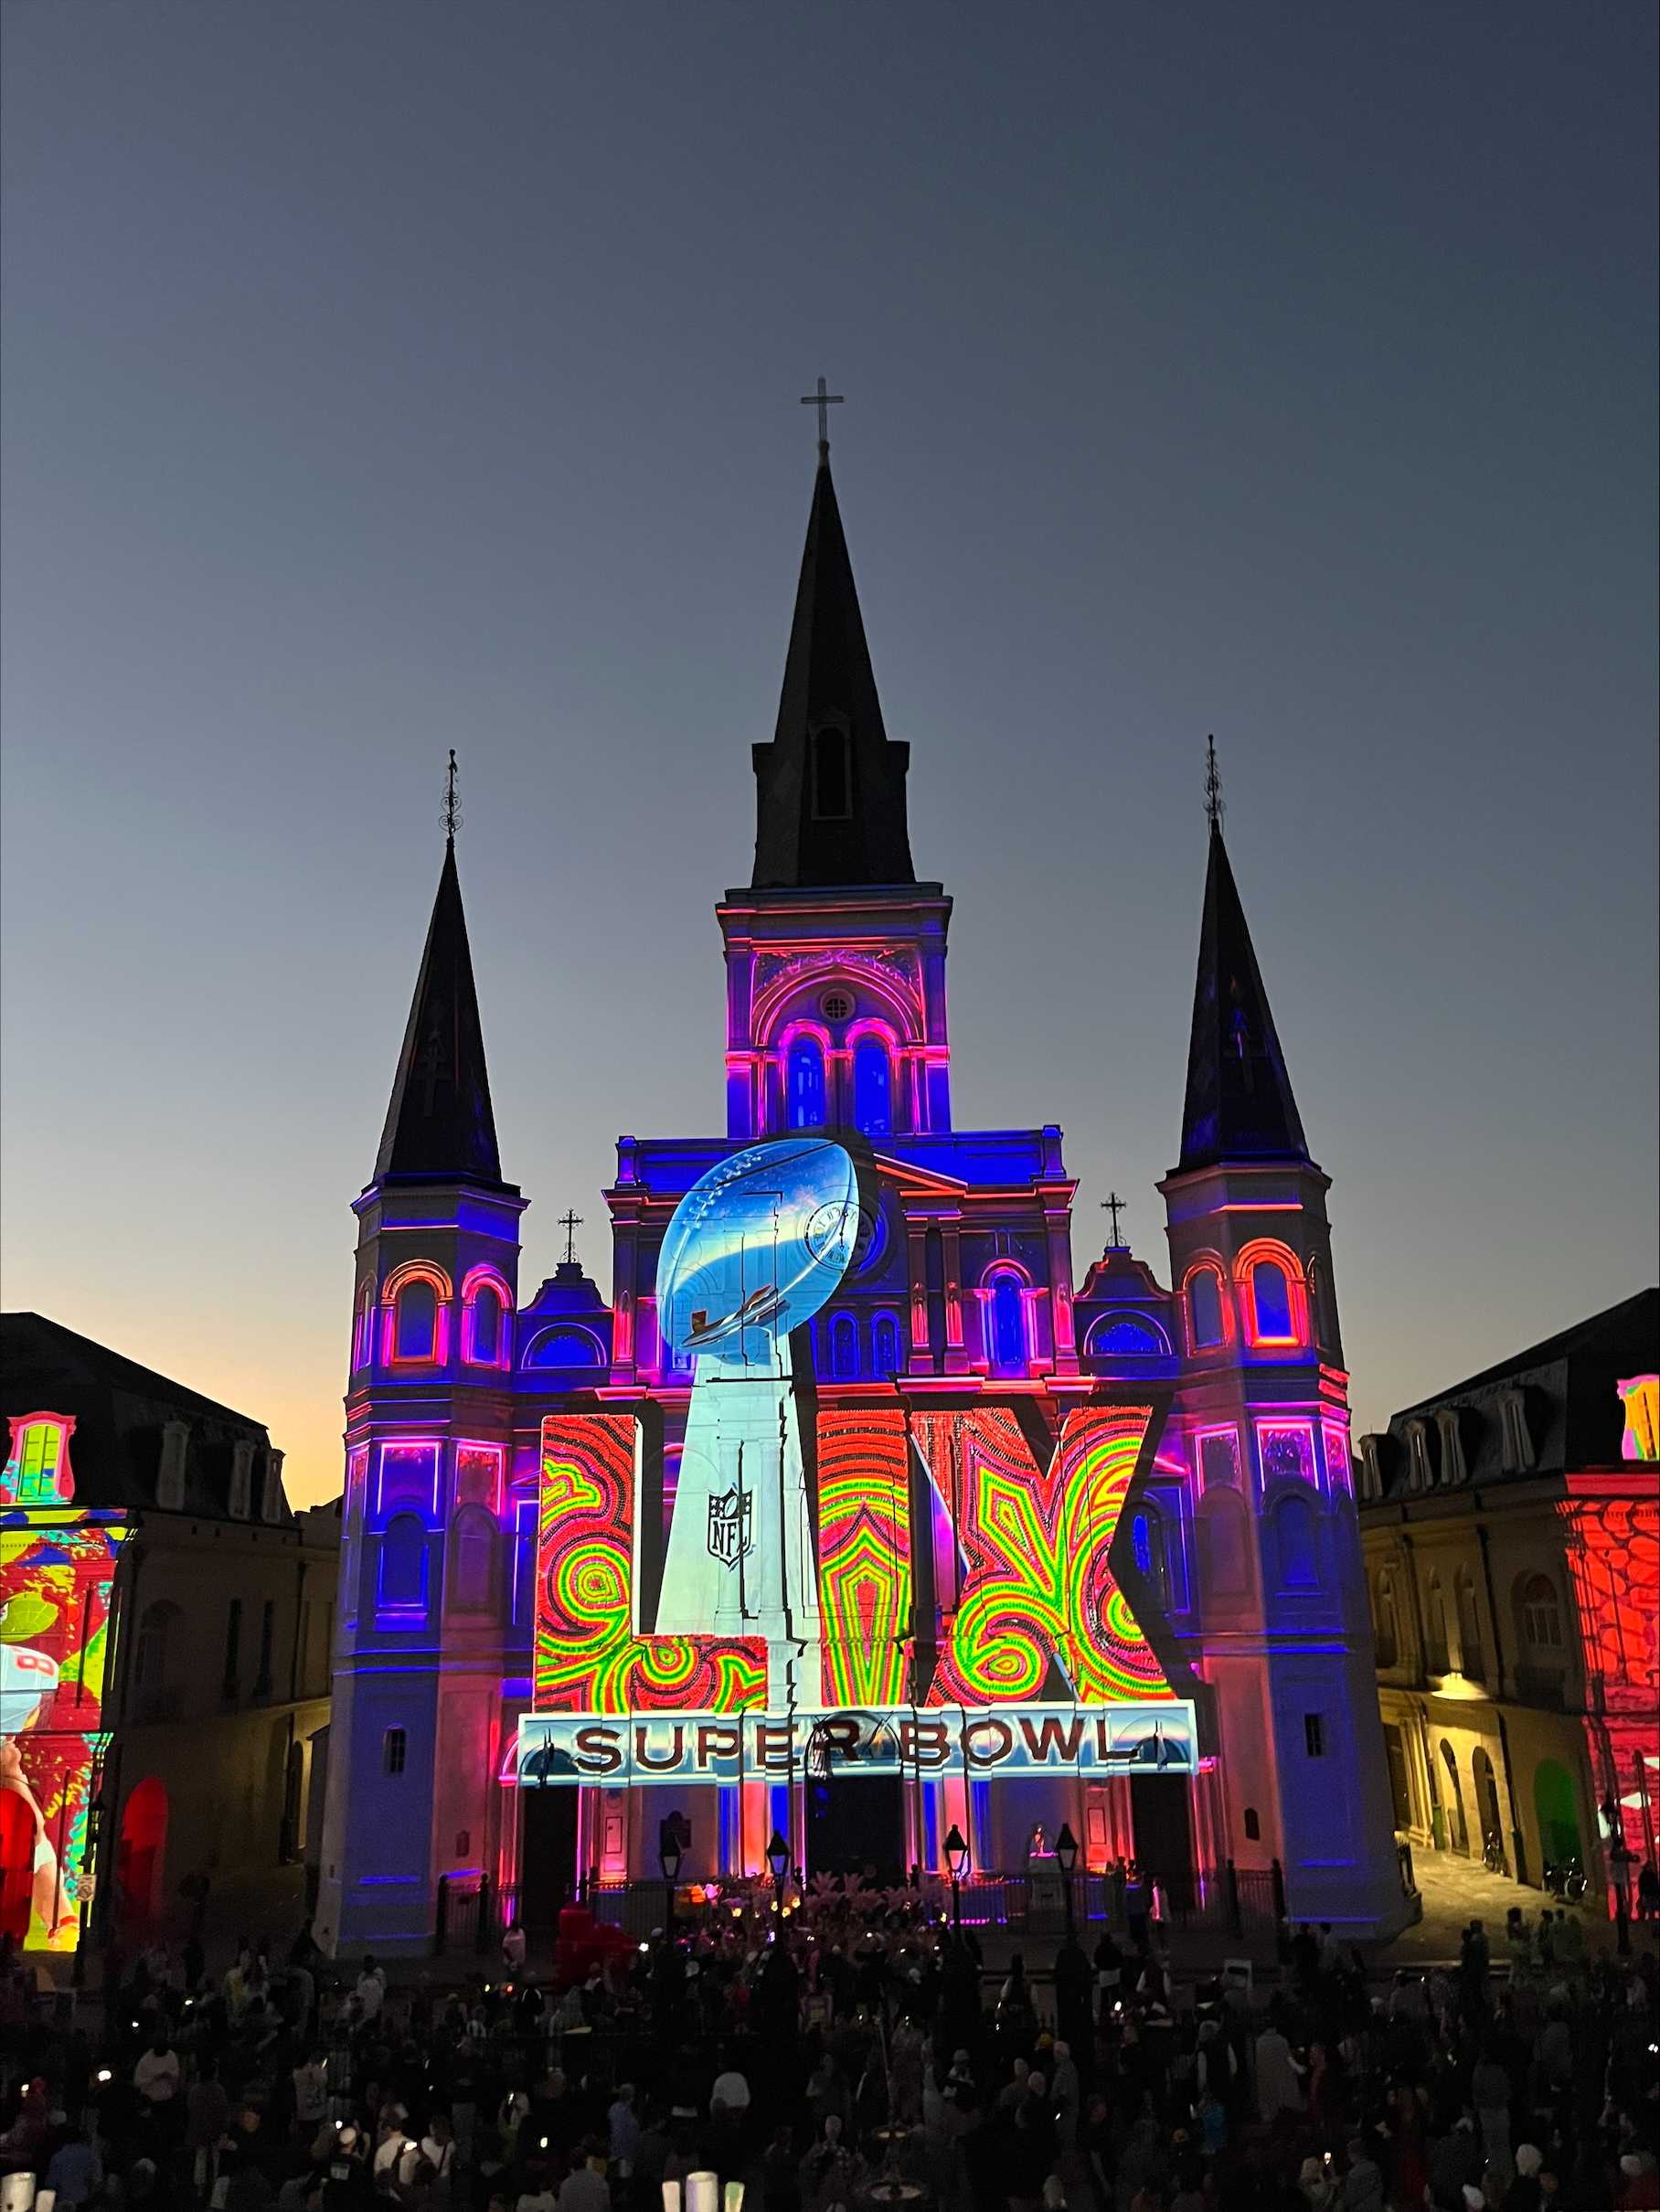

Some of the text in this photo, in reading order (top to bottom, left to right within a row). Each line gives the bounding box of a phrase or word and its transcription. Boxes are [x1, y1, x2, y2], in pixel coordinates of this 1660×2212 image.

[534, 1406, 1177, 1713] LIX
[712, 1520, 748, 1558] NFL
[575, 1717, 1141, 1771] SUPER BOWL
